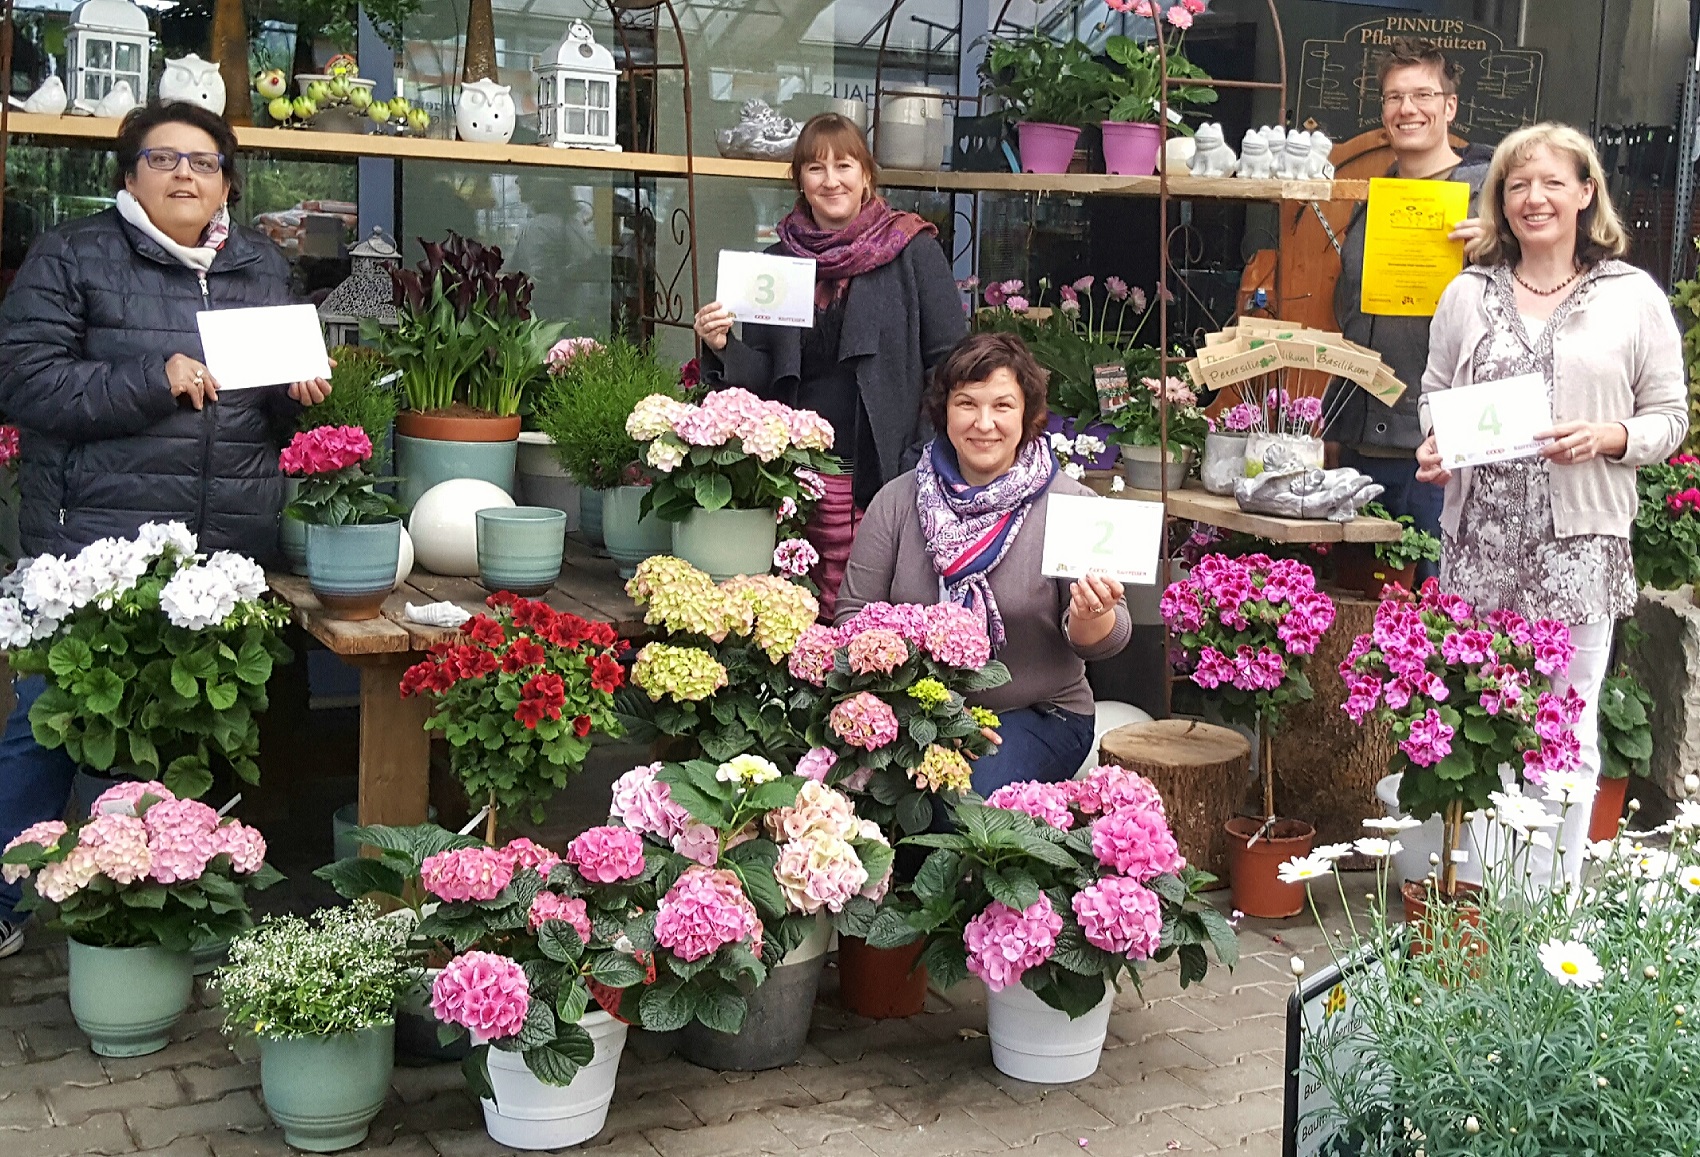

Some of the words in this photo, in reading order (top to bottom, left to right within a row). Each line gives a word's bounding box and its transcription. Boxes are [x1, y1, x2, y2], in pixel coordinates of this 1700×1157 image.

[1386, 16, 1464, 34] PINNUPS
[1361, 28, 1487, 50] Pflastützen
[755, 273, 775, 304] 3
[1209, 360, 1261, 383] Petersilie
[1317, 353, 1369, 377] Basilikum
[1478, 404, 1502, 435] 4
[1092, 519, 1115, 554] 2
[1303, 1080, 1325, 1100] Bus
